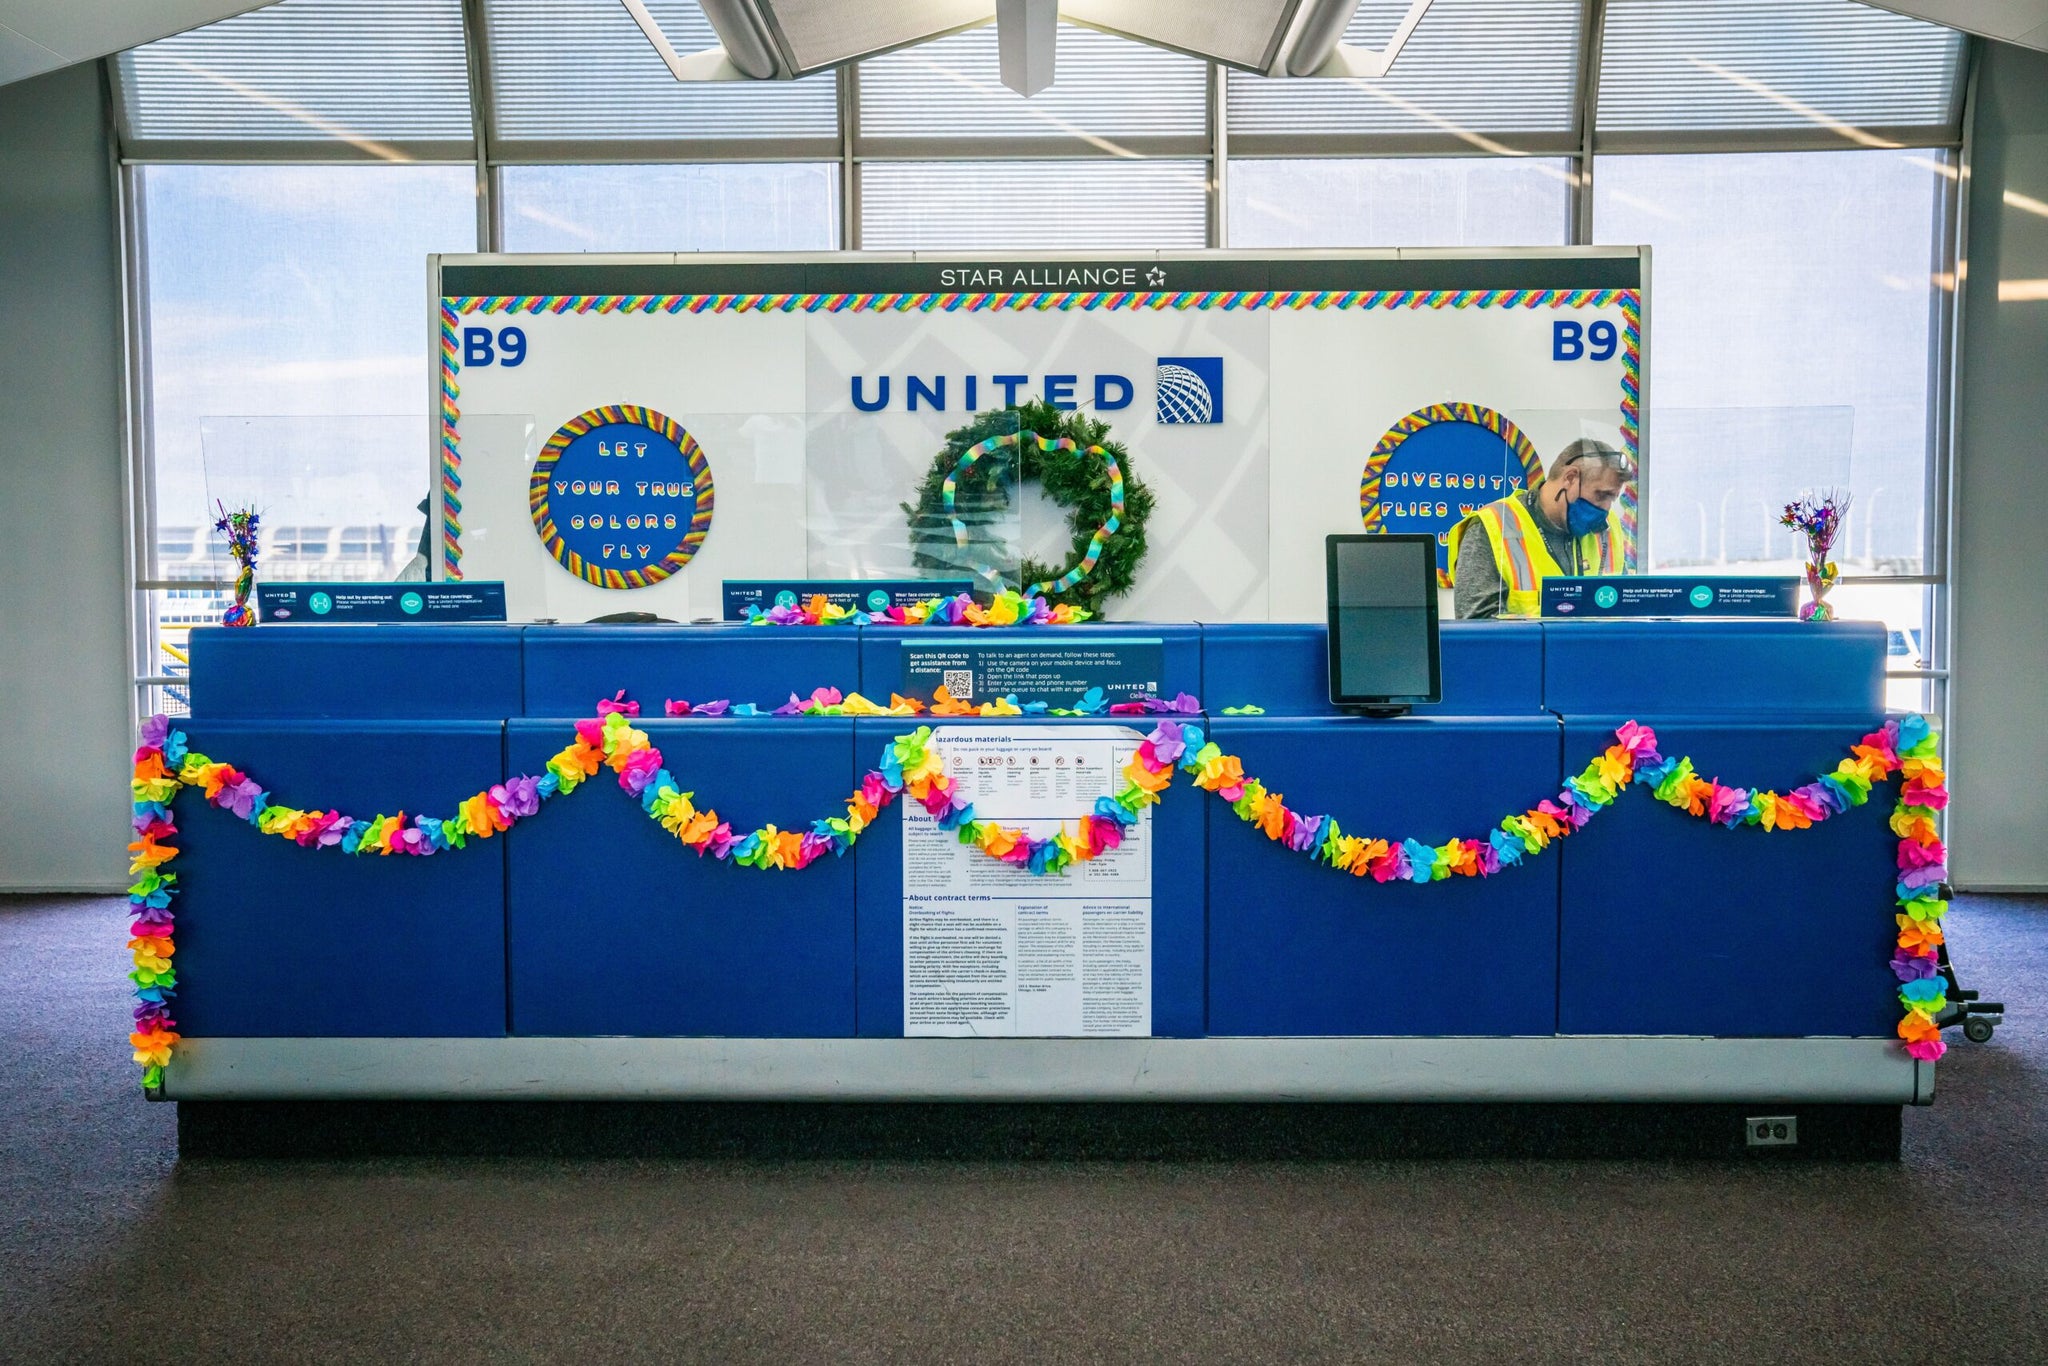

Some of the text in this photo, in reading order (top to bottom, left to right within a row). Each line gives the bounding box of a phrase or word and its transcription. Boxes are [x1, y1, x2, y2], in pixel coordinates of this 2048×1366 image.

[940, 268, 1136, 286] STAR ALLIANCE
[464, 327, 526, 367] B9
[1553, 320, 1617, 361] B9
[851, 374, 1134, 412] UNITED
[598, 442, 647, 458] LET
[554, 480, 693, 497] YOUR TRUE
[1385, 472, 1522, 490] DIVERSITY
[1381, 502, 1447, 517] FLIES
[571, 514, 676, 530] COLORS
[603, 544, 650, 559] FLY
